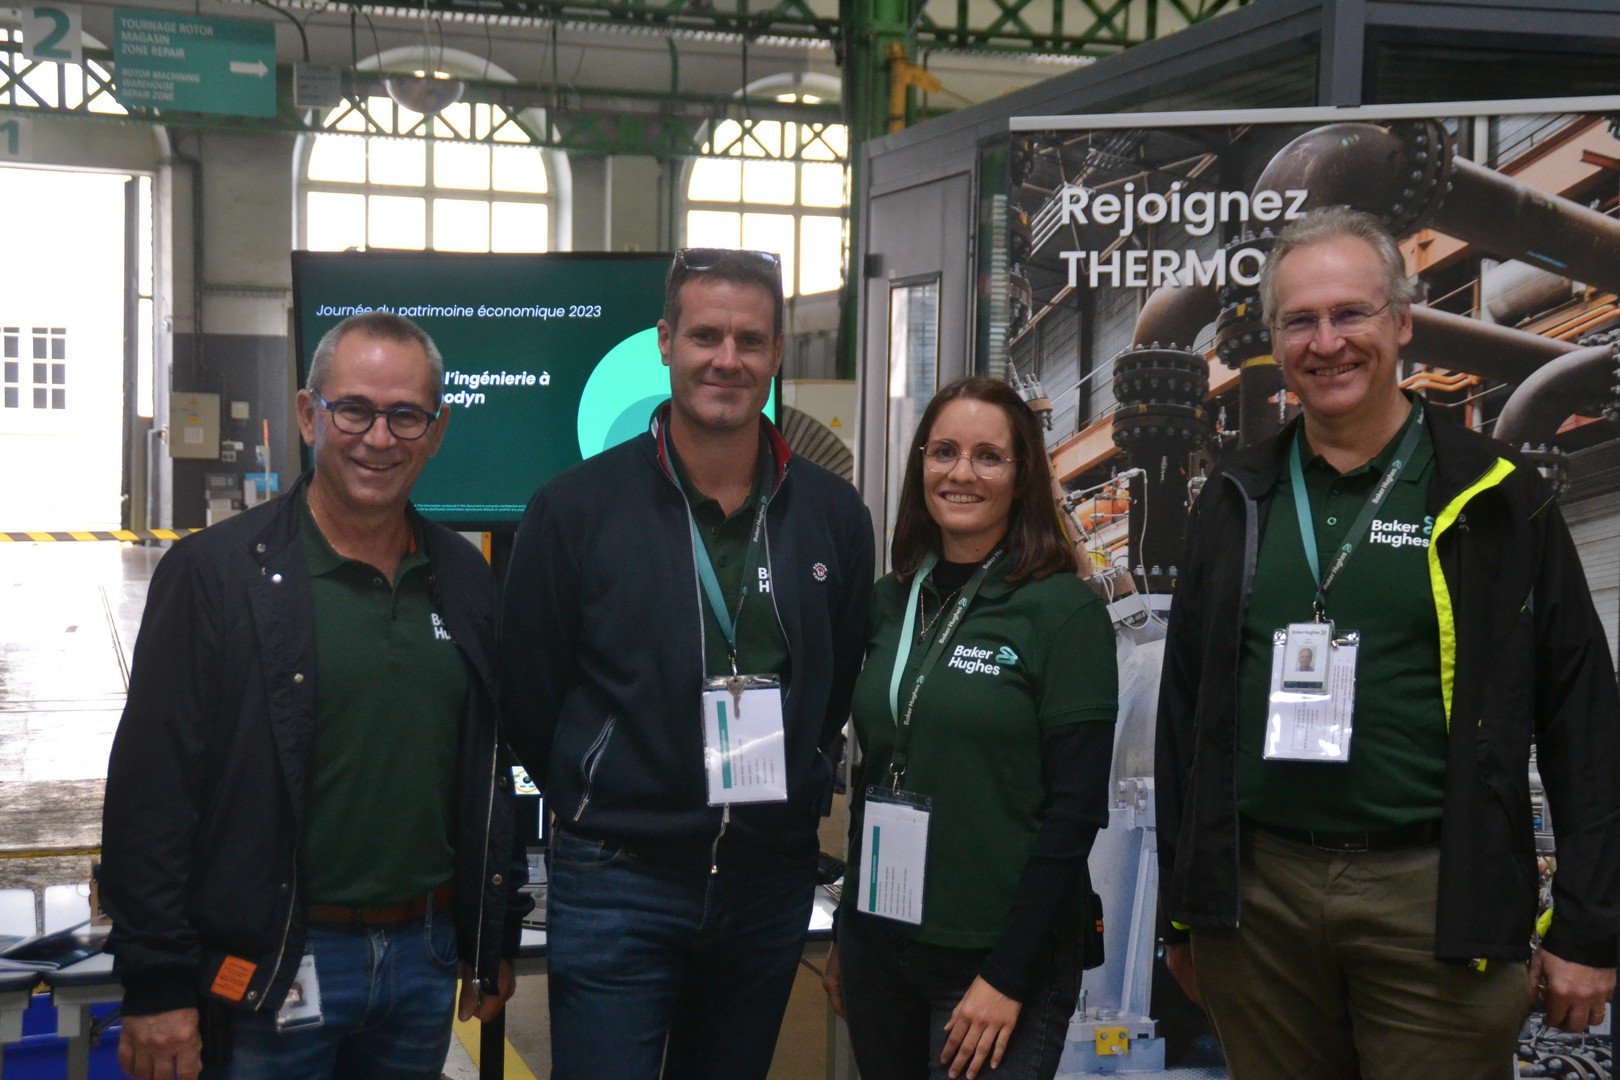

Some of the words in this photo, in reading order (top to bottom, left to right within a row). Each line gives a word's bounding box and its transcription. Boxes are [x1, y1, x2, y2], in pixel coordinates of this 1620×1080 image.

[34, 7, 72, 59] 2
[121, 17, 177, 33] TOURNAGE
[178, 22, 214, 37] ROTOR
[121, 30, 170, 45] MAGASIN
[121, 42, 148, 56] ZONE
[151, 45, 186, 59] REPAIR
[1060, 180, 1309, 237] Rejoignez
[1059, 247, 1266, 288] THERMO
[316, 304, 373, 316] Journée
[398, 304, 474, 317] patrimoine
[477, 304, 565, 321] économique
[568, 305, 602, 317] 2023
[444, 370, 536, 389] l'ingénierie
[538, 370, 551, 385] à
[441, 390, 486, 408] odyn
[1372, 487, 1386, 504] Baker
[1382, 468, 1398, 489] Hughes
[1371, 519, 1420, 533] Baker
[1369, 531, 1430, 548] Hughes
[939, 625, 951, 644] Baker
[948, 606, 963, 627] Hughes
[954, 645, 993, 660] Baker
[948, 656, 1000, 676] Hughes
[903, 705, 913, 726] Baker
[908, 684, 920, 707] Hughes
